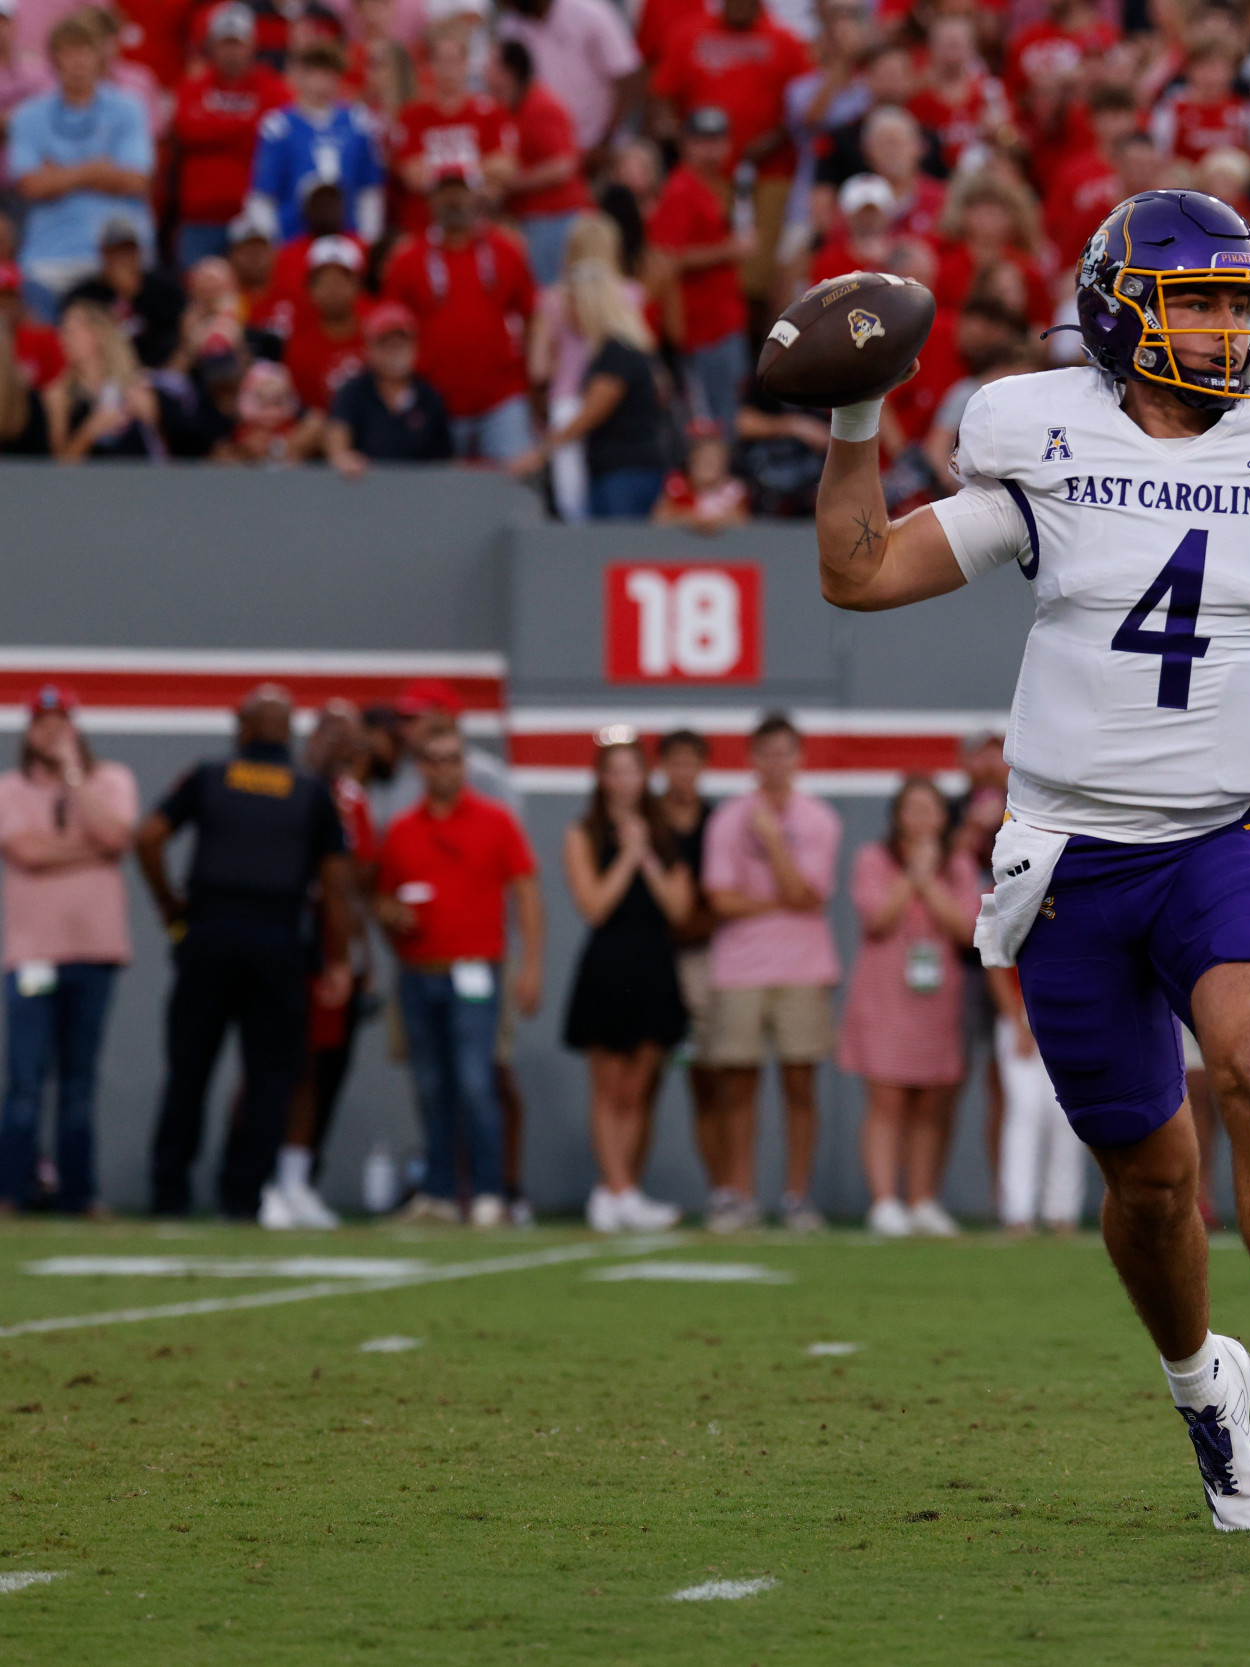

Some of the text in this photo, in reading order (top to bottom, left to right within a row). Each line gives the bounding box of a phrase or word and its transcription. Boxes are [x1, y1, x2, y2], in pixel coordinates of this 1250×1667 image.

[1064, 475, 1132, 506] EAST
[625, 570, 742, 677] 18
[1111, 528, 1211, 710] 4
